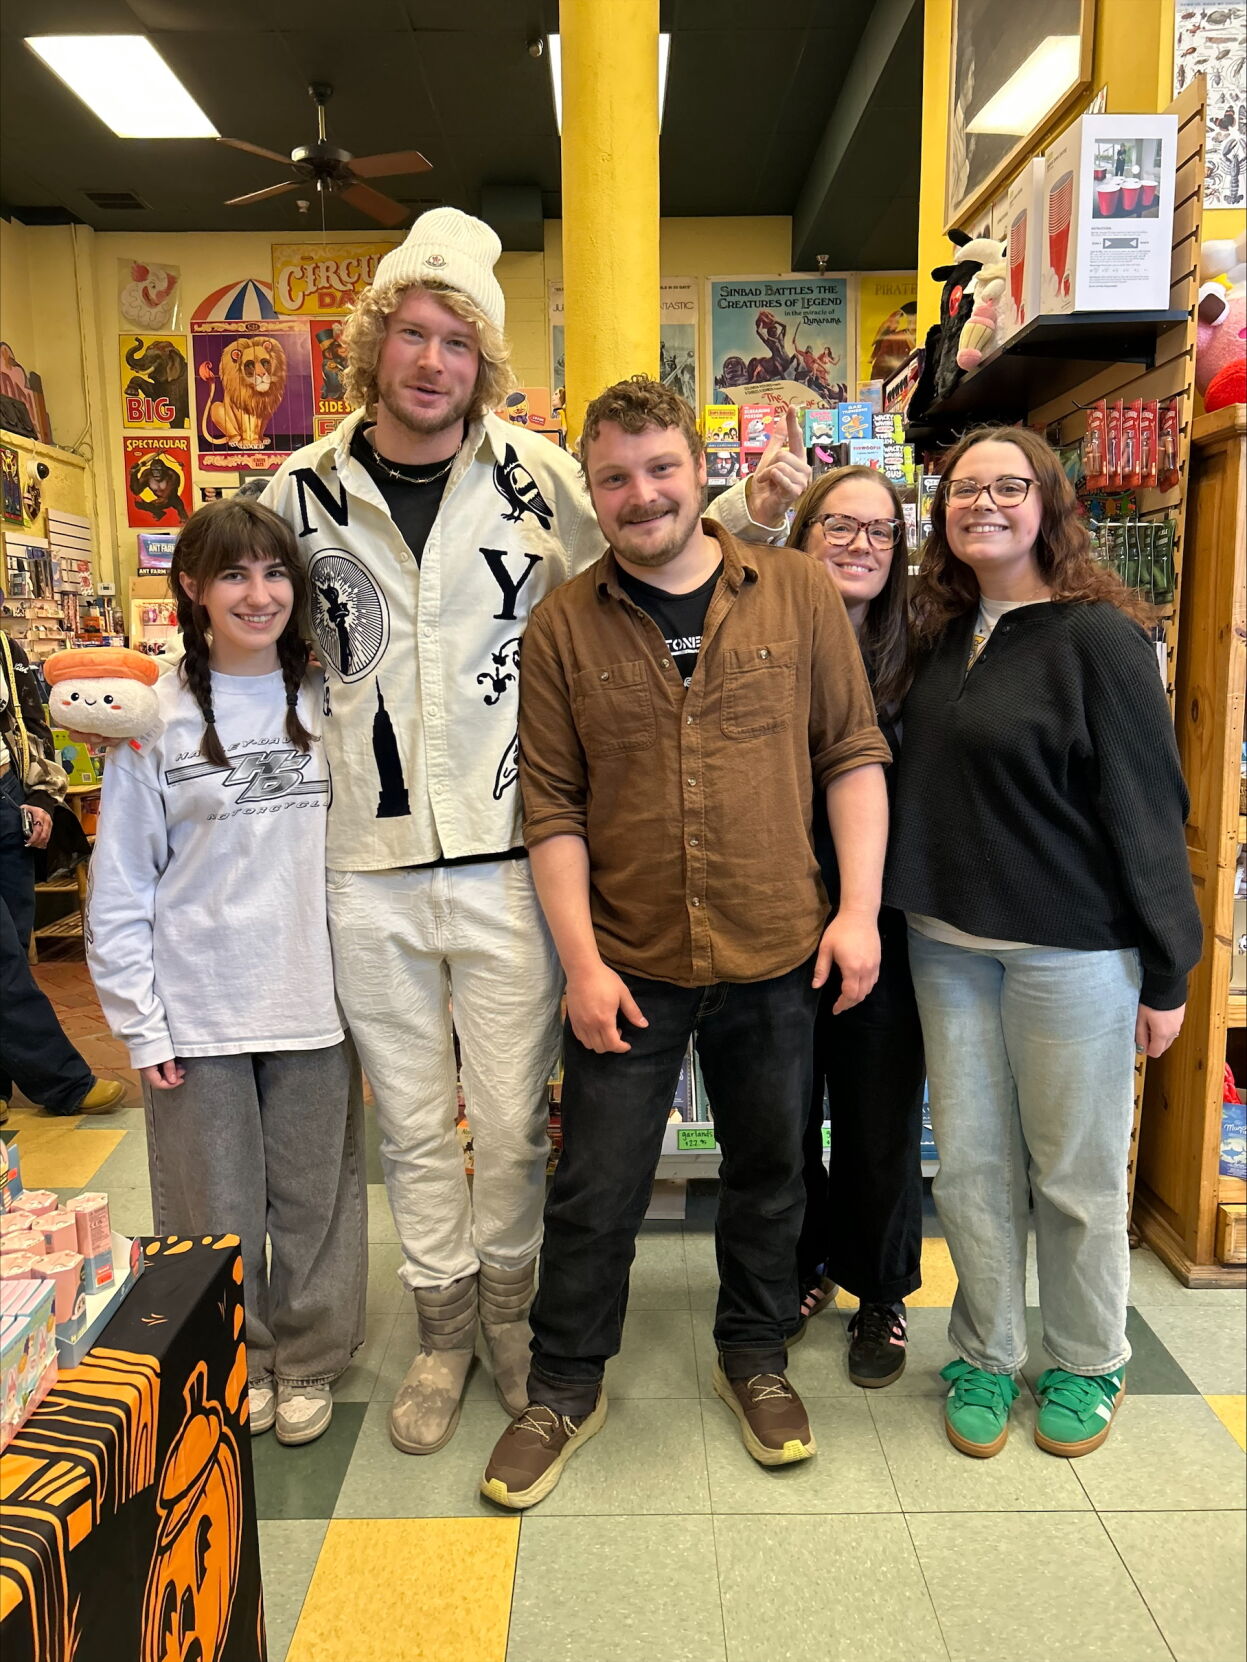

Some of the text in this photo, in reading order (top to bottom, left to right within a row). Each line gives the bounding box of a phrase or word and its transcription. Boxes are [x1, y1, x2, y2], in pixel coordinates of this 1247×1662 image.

[720, 284, 838, 297] SINBAD BATTLES THE
[718, 296, 842, 309] CREATURES OF LEGEND
[126, 396, 176, 423] BIG
[318, 400, 344, 413] SIDE
[126, 439, 188, 451] SPECTACULAR
[289, 467, 349, 538] N
[149, 543, 161, 552] ANT
[479, 548, 544, 620] Y
[665, 636, 703, 651] TONE
[682, 1131, 713, 1141] garlands
